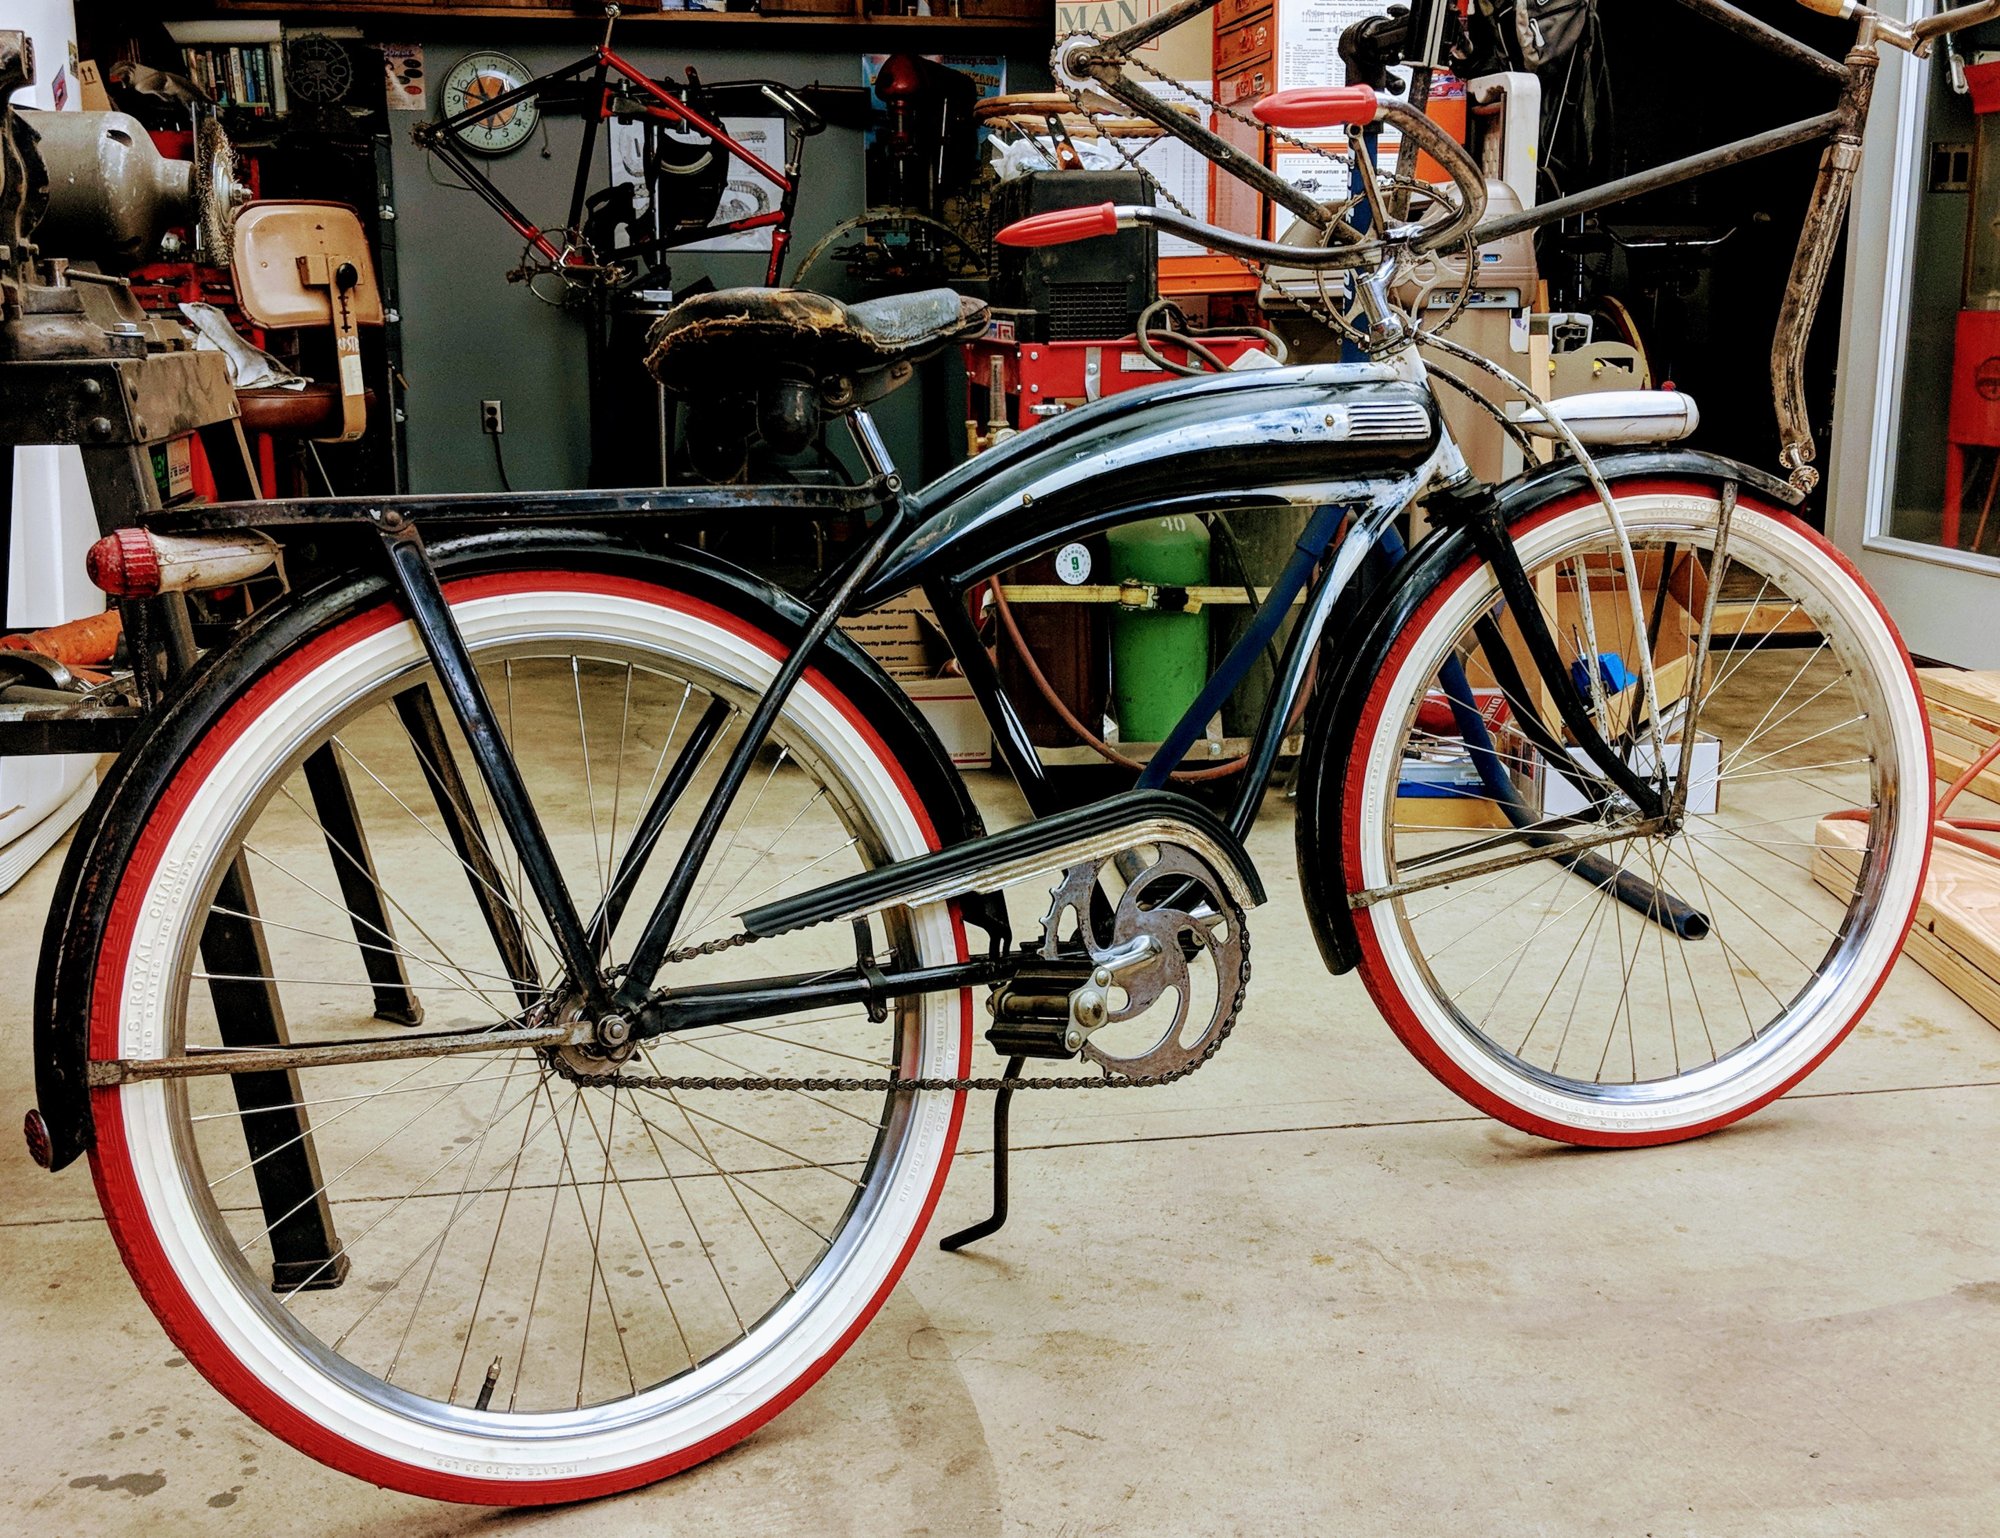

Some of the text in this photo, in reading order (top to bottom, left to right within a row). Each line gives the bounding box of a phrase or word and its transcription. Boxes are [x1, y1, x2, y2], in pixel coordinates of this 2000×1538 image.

[1060, 0, 1137, 32] MAN
[457, 80, 469, 89] 10
[452, 95, 460, 104] 9
[520, 102, 528, 112] 3
[514, 119, 522, 127] 4
[502, 128, 509, 138] 5
[1161, 516, 1186, 532] 40
[1071, 555, 1080, 571] 9
[149, 859, 182, 920] CHAIN
[157, 914, 173, 946] TIRE
[171, 841, 204, 904] COMPANY
[485, 1465, 501, 1475] TO
